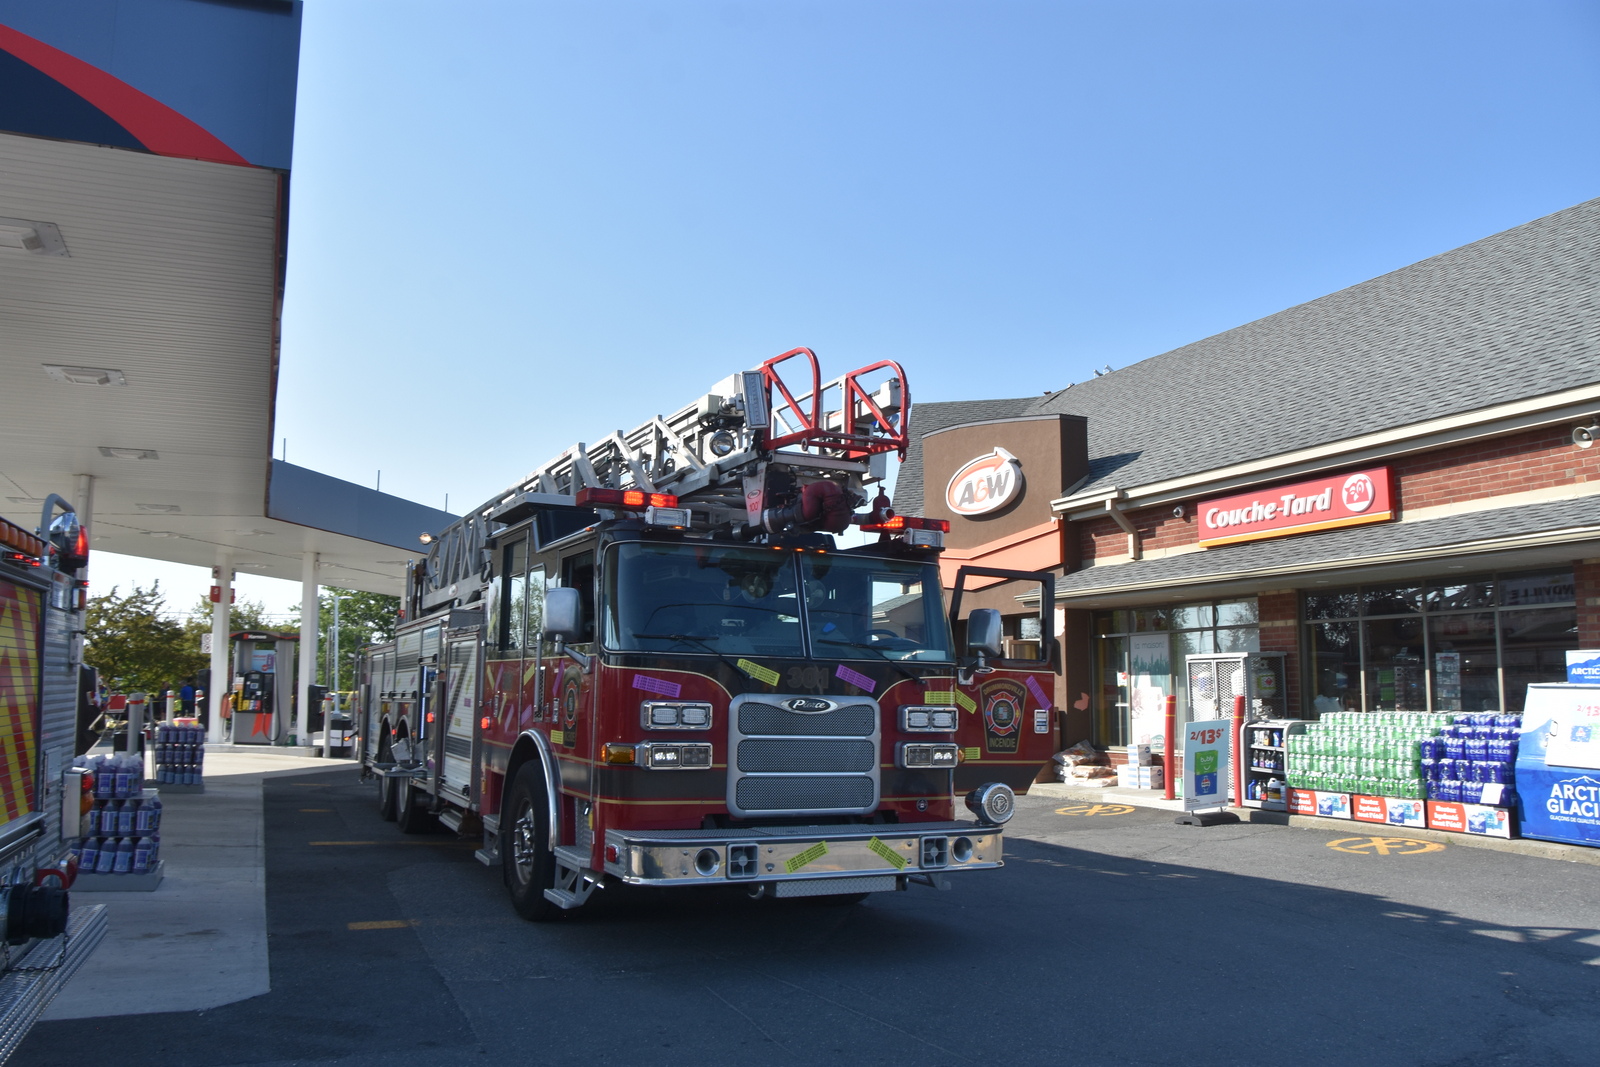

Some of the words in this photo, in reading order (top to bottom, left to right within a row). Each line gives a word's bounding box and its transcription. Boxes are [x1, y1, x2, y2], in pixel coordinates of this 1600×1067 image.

[957, 469, 1010, 507] A&W
[1205, 487, 1333, 529] Couche-Tard
[786, 666, 829, 689] 301
[982, 682, 1024, 697] DRUMMONDVILLE
[989, 737, 1016, 748] INCENDIE
[1550, 783, 1600, 802] ARCT
